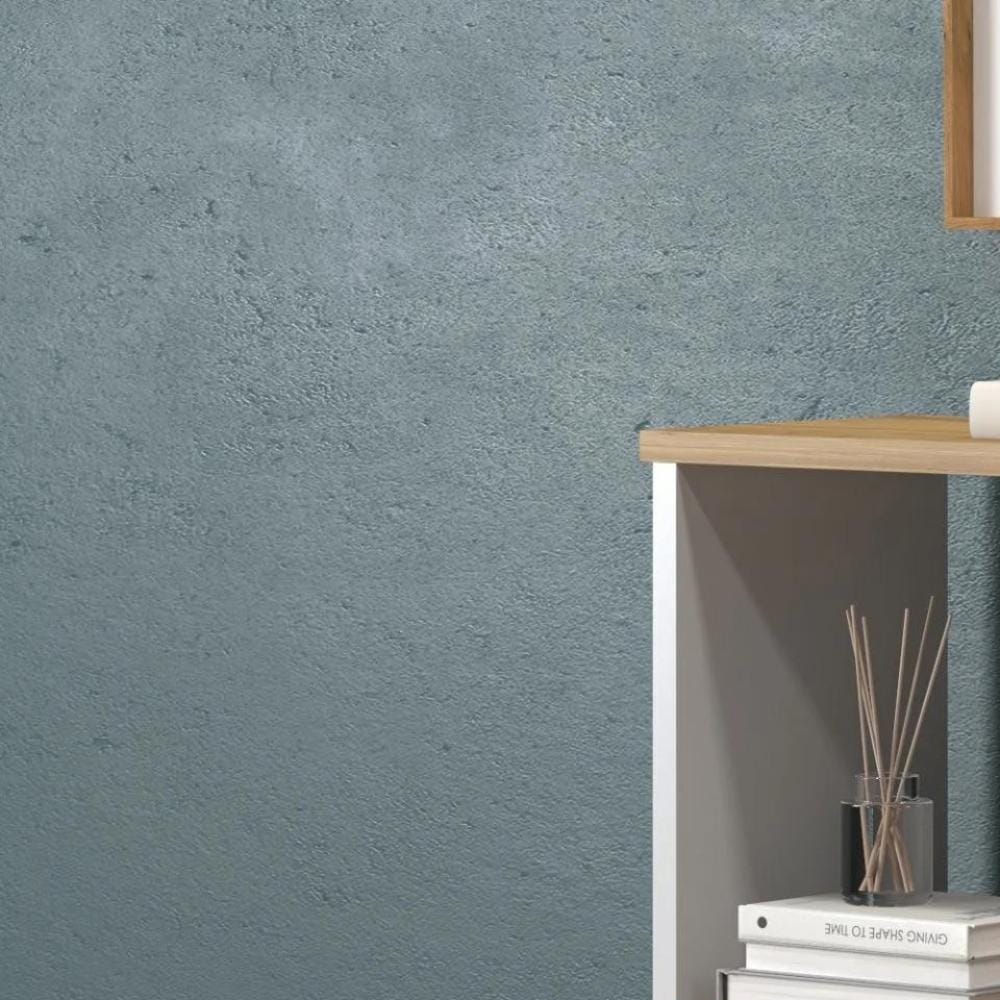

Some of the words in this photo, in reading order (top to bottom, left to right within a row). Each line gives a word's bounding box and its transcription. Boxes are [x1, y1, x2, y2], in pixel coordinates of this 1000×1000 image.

[824, 922, 848, 937] TIME
[851, 925, 867, 938] TO
[869, 926, 904, 942] SHAPE
[906, 929, 948, 946] GIVING
